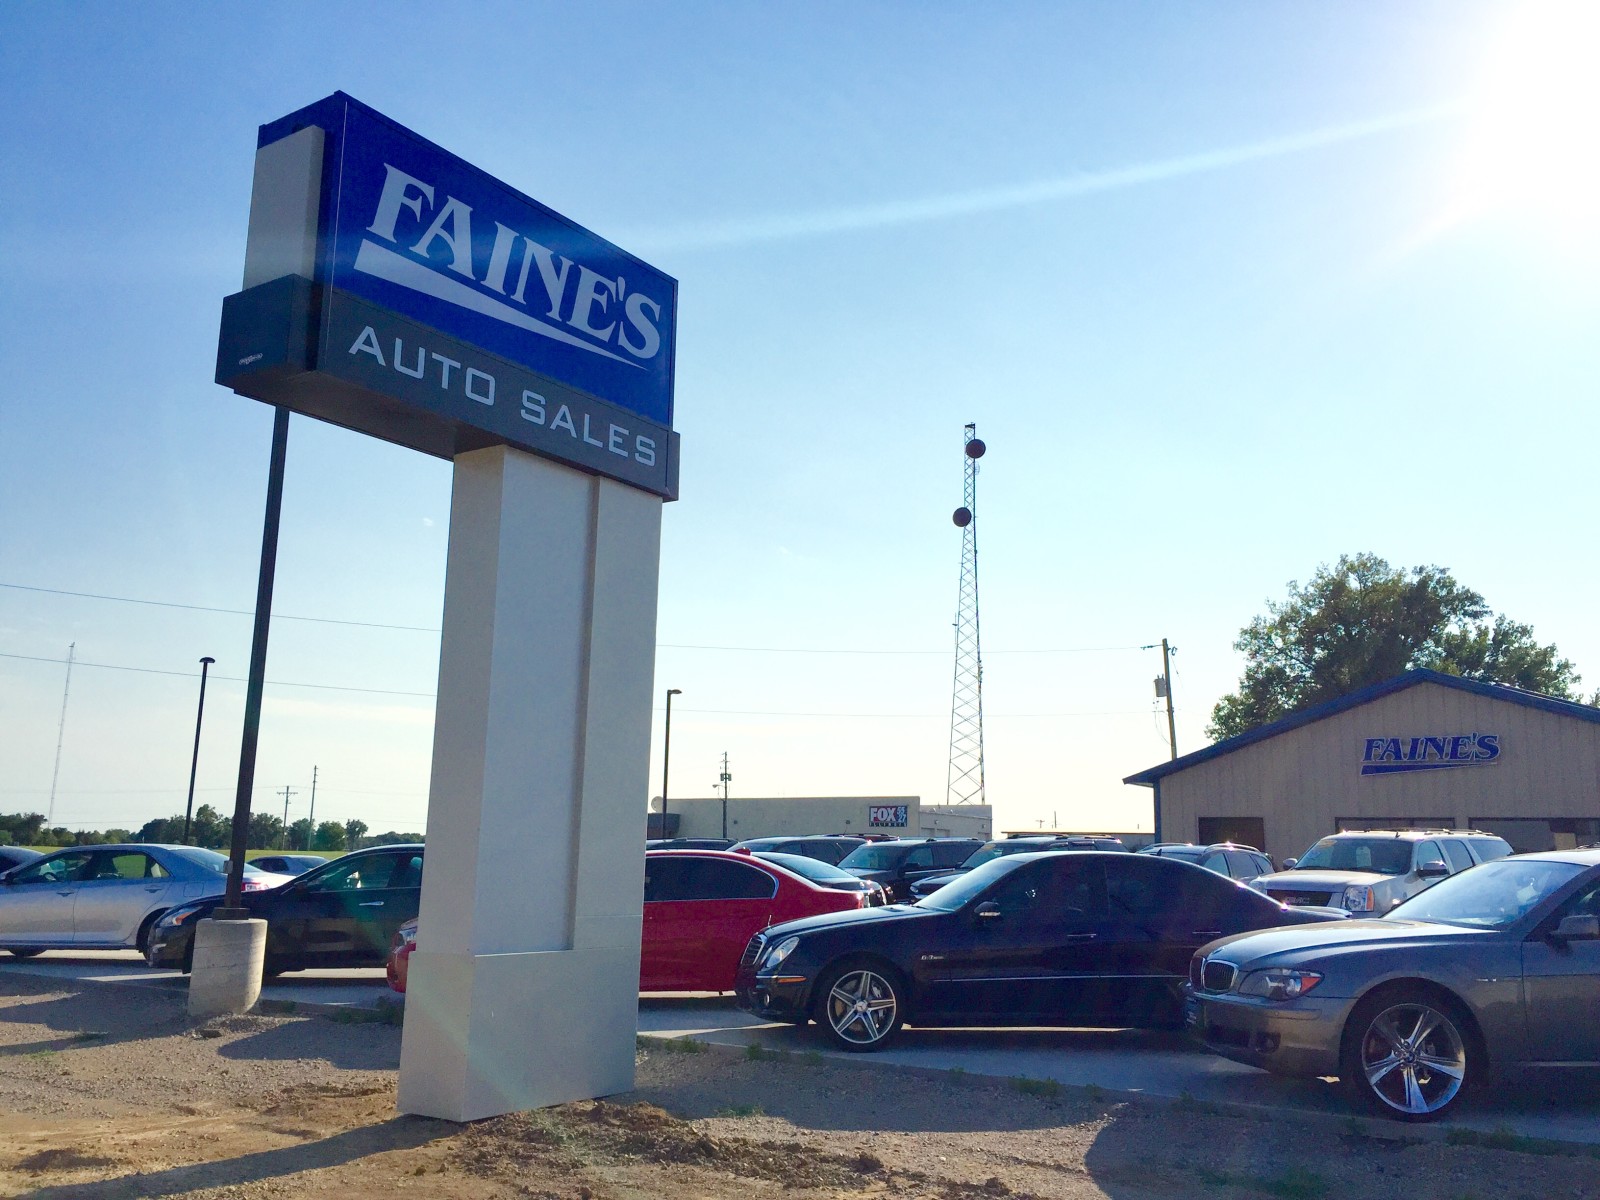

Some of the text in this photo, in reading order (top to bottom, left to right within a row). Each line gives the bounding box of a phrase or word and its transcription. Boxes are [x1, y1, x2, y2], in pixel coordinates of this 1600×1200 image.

[366, 163, 661, 360] FAINE'S
[349, 326, 657, 467] AUTO SALES
[1361, 733, 1500, 762] FAINE'S
[870, 807, 896, 822] FOX
